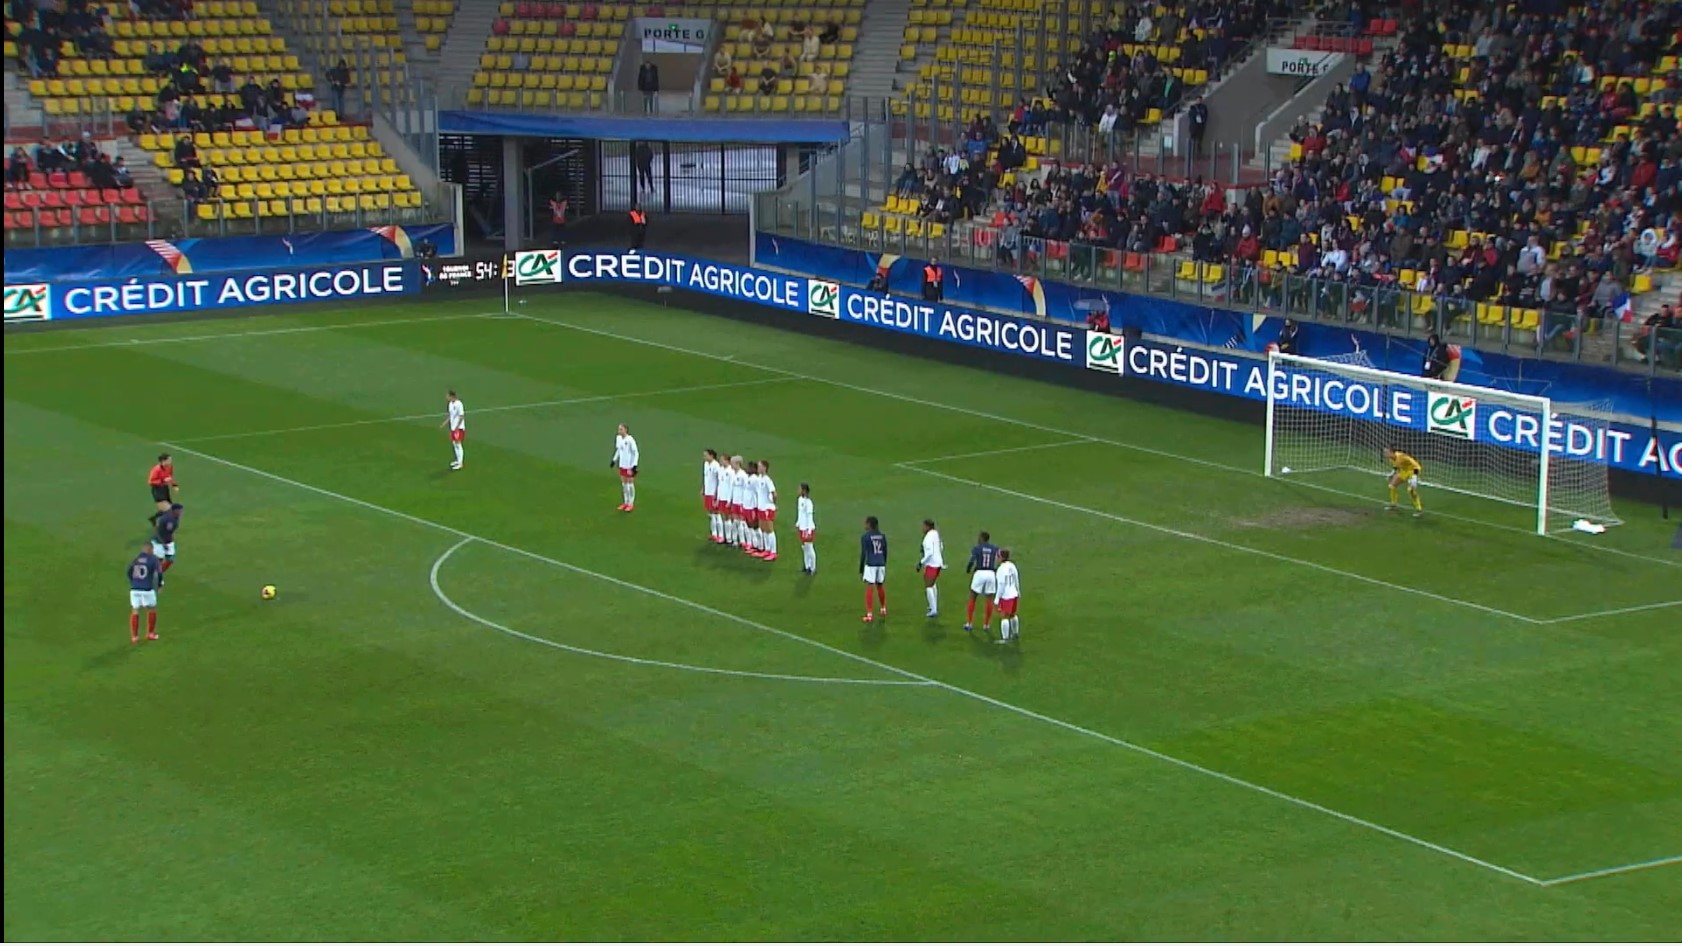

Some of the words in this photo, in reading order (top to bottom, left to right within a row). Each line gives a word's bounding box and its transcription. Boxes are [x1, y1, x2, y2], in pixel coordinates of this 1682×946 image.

[644, 28, 690, 39] PORTE
[1282, 61, 1319, 74] PORTE
[65, 278, 209, 315] CRÉDIT
[218, 266, 403, 303] AGRICOLE
[569, 249, 685, 283] CRÉDIT
[689, 264, 799, 306] AGRICOLE
[847, 292, 934, 333] CRÉDIT
[939, 310, 1073, 360] AGRICOLE
[1129, 347, 1237, 389] CRÉDIT
[1244, 364, 1412, 423] AGRICOLE
[1488, 411, 1631, 462] CRÉDIT
[872, 540, 883, 555] 12
[982, 553, 990, 568] 11
[132, 564, 148, 580] 10
